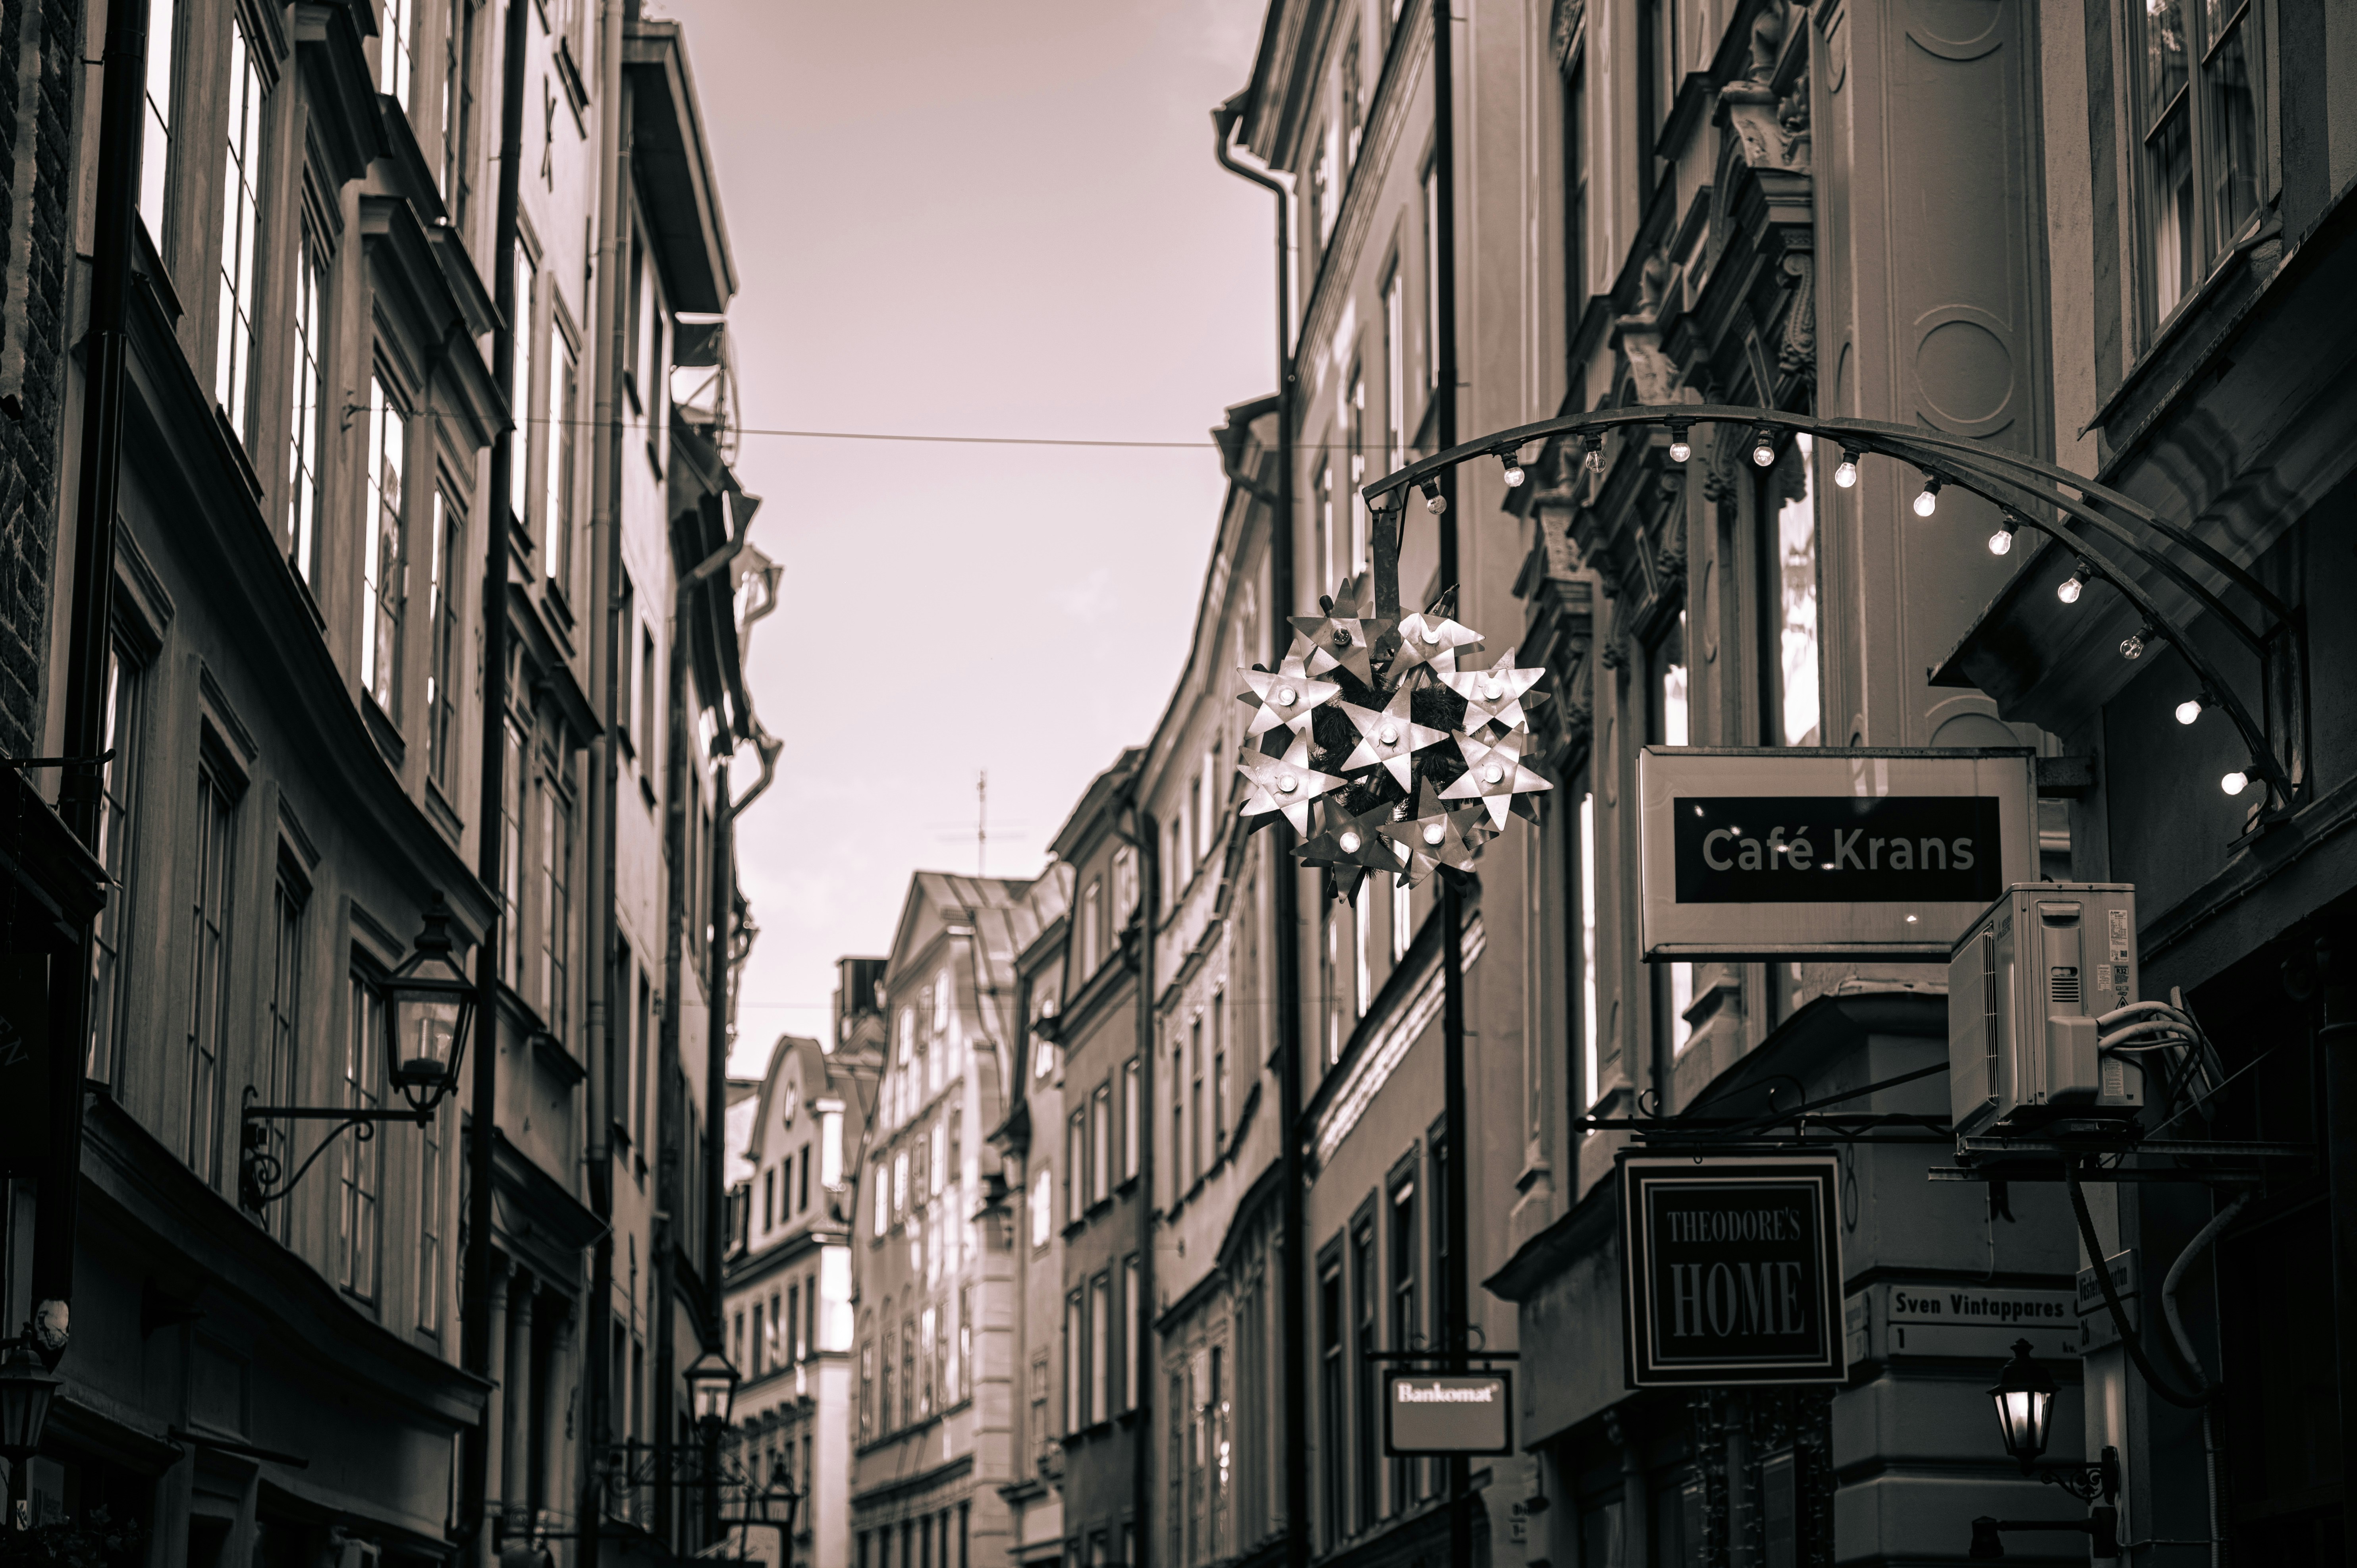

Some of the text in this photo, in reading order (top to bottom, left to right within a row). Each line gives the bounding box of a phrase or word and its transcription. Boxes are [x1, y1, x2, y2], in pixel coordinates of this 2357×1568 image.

[1703, 825, 1974, 871] Café Krans
[1667, 1207, 1801, 1242] THEODORE'S
[2079, 1266, 2127, 1302] Västerlatan
[1670, 1262, 1805, 1337] HOME
[1896, 1292, 1940, 1314] Sven
[1950, 1294, 2064, 1321] Vintappares
[1898, 1328, 1904, 1348] 1
[2081, 1318, 2089, 1346] 26
[2063, 1341, 2076, 1353] kv.
[1397, 1382, 1493, 1402] Bankomat
